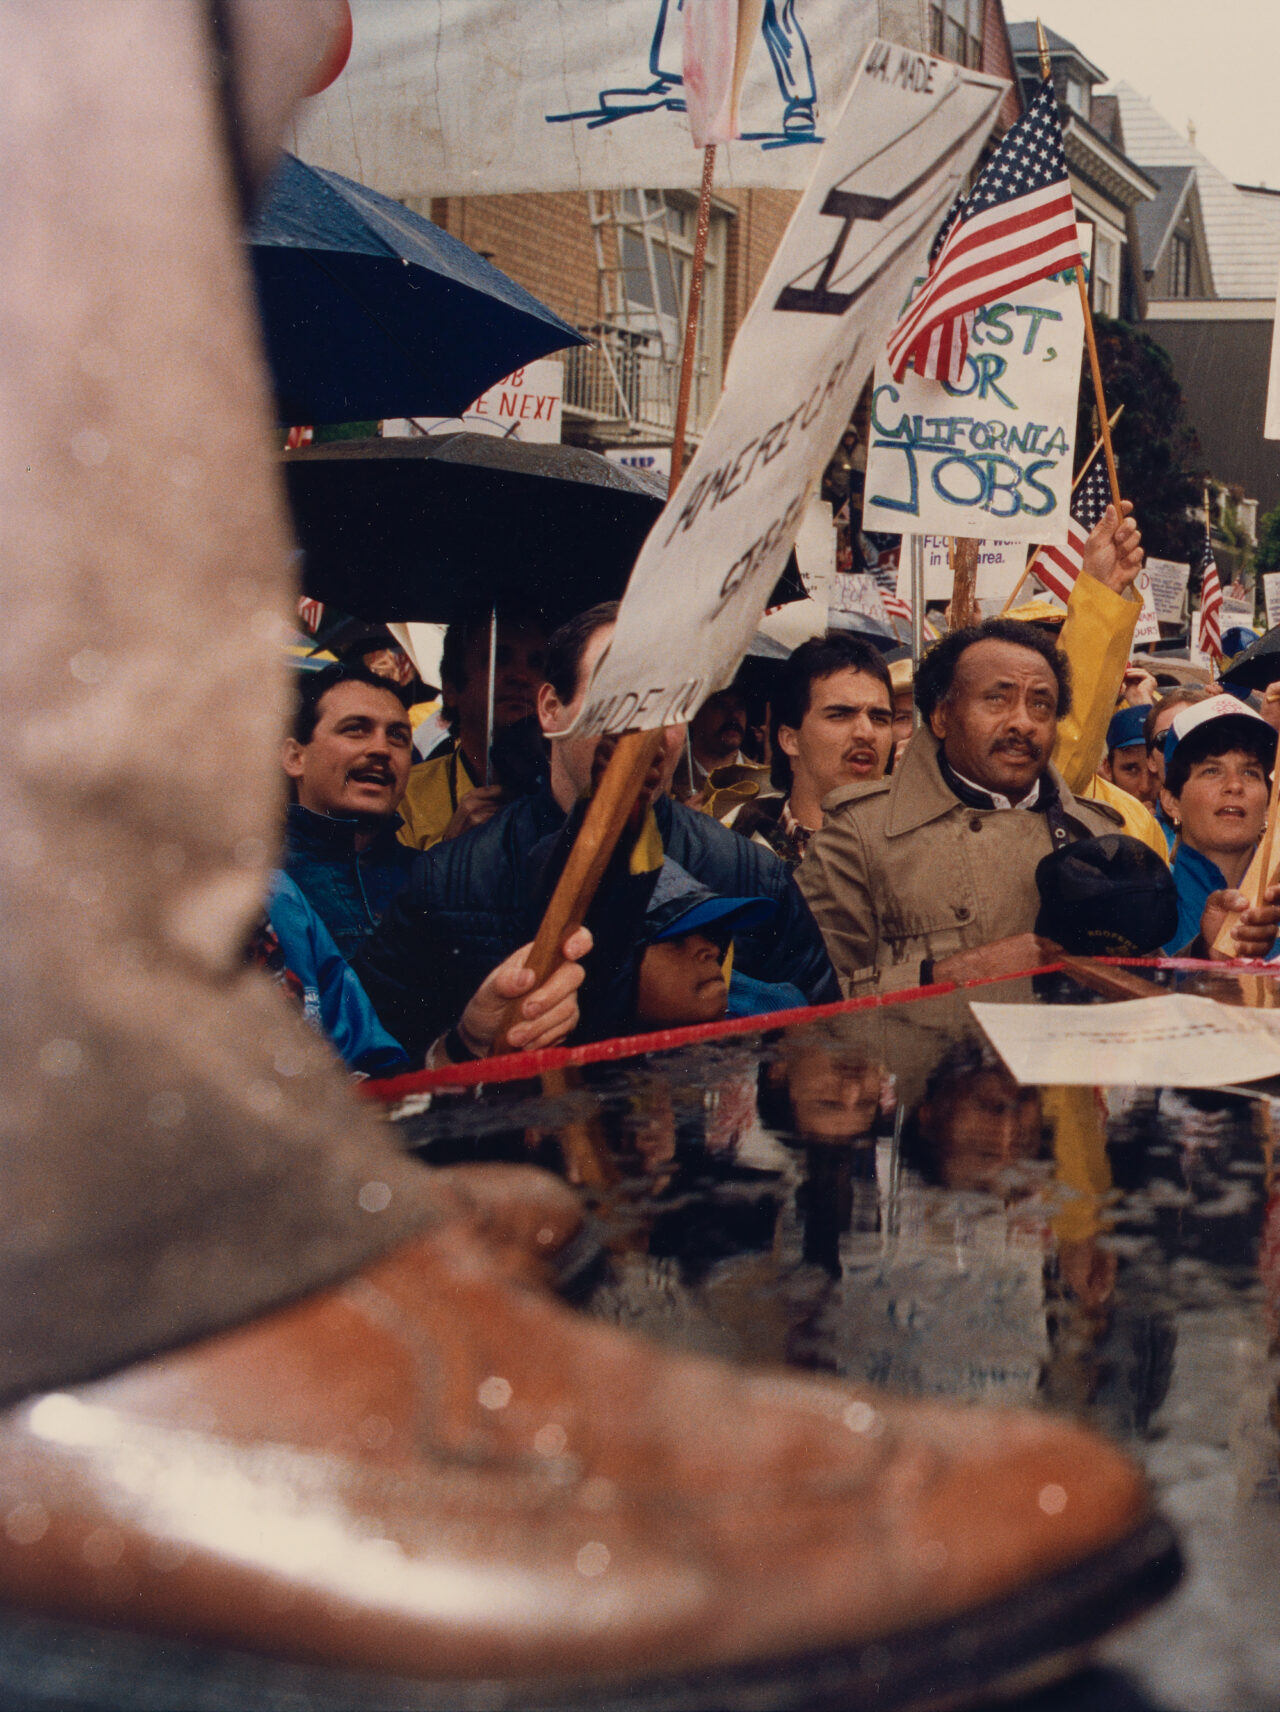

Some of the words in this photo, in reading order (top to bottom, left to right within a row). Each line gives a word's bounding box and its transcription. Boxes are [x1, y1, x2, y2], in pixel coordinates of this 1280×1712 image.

[499, 391, 561, 421] NEXT
[871, 384, 1069, 457] CALIFORNIA
[868, 439, 1058, 518] JOBS
